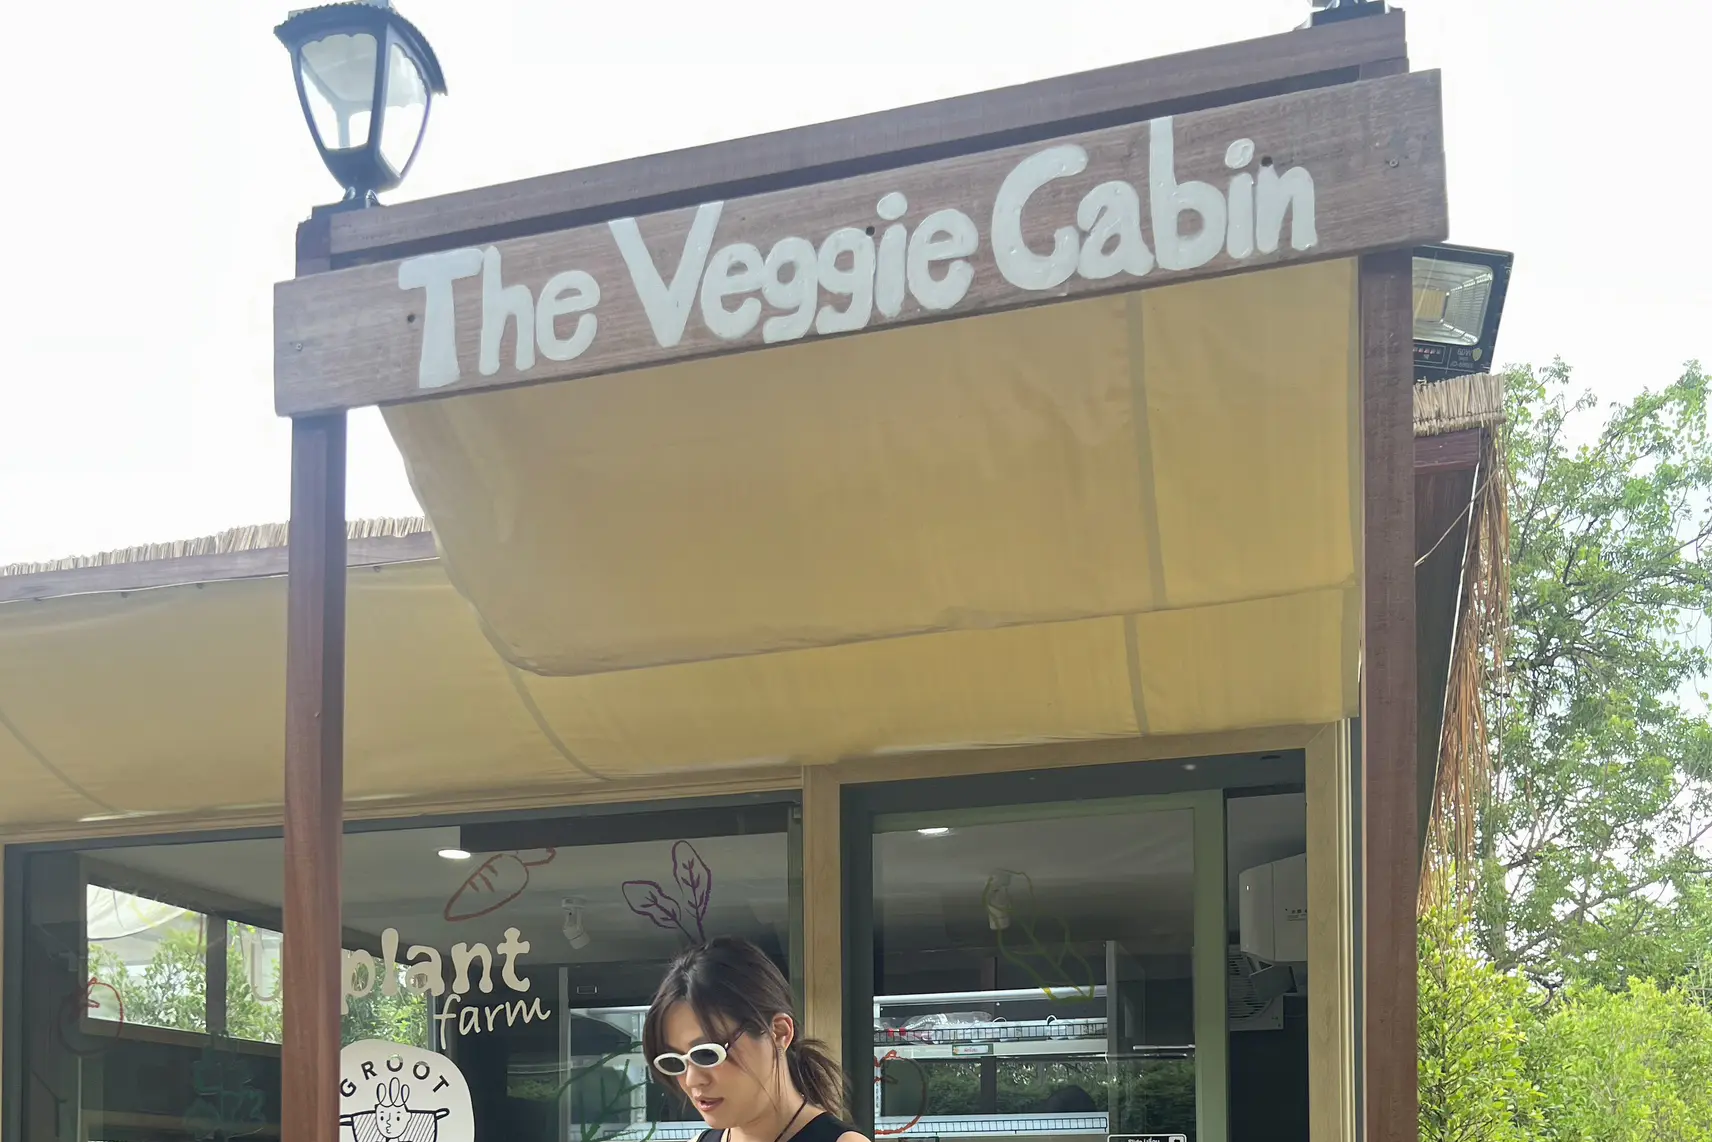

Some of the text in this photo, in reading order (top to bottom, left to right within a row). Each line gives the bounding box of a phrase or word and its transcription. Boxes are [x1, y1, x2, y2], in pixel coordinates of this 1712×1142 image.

[398, 115, 1318, 389] The Veggie Cabin
[433, 993, 551, 1050] farm
[340, 1054, 450, 1098] GROOT
